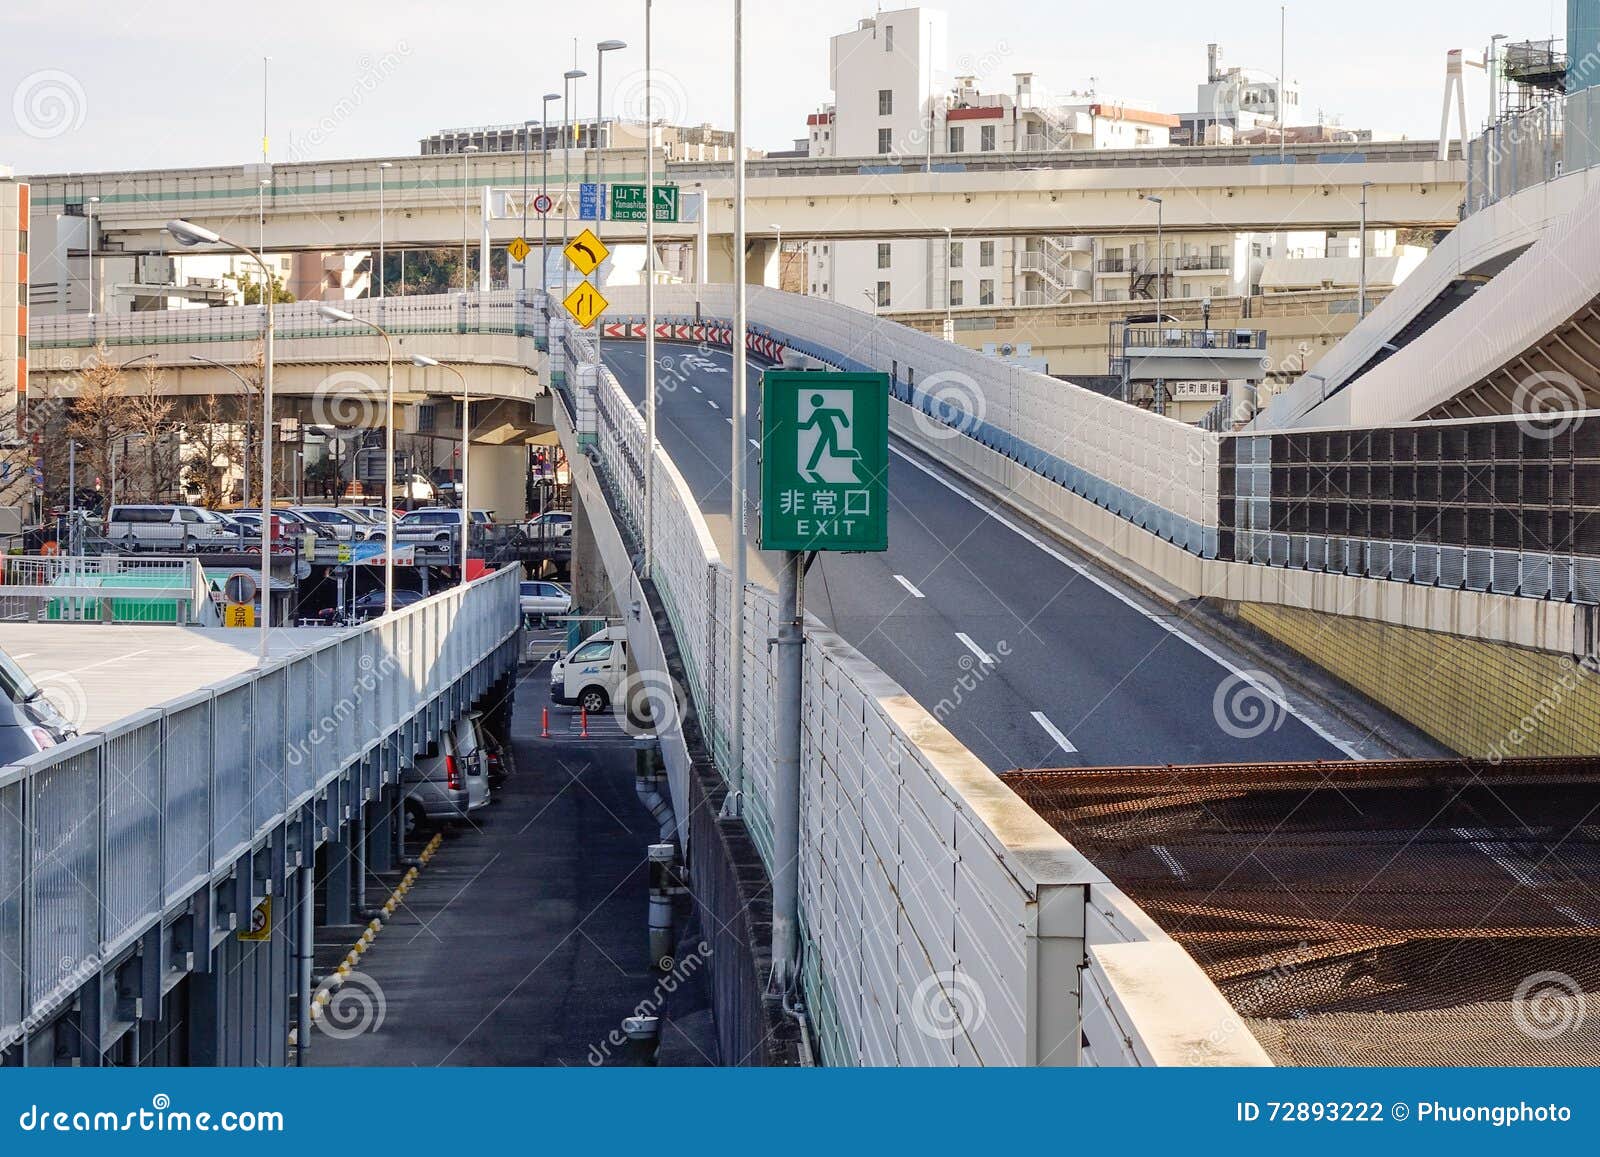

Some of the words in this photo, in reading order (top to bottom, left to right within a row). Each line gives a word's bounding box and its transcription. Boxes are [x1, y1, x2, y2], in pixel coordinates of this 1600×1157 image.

[615, 200, 654, 208] Yamashitac
[1178, 383, 1219, 394] 元町眼科
[780, 489, 870, 516] 非常口
[797, 520, 856, 535] EXIT
[234, 607, 247, 627] 合流
